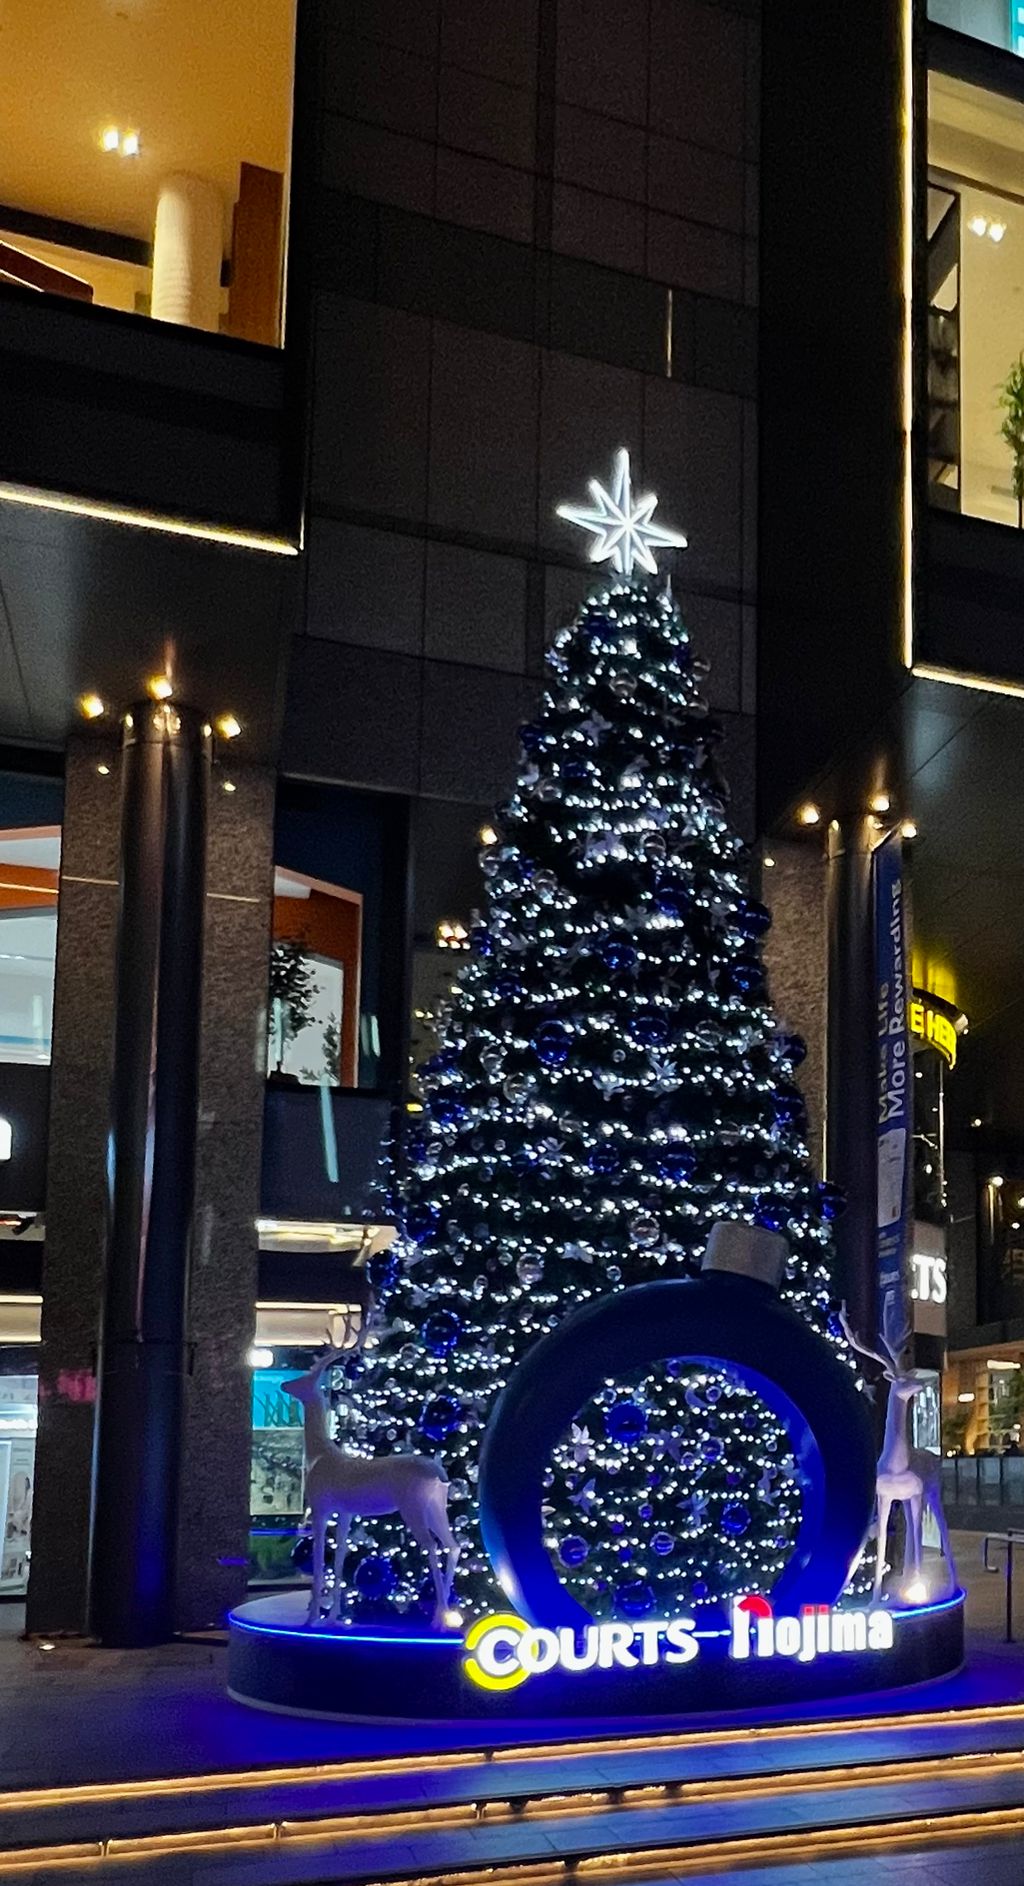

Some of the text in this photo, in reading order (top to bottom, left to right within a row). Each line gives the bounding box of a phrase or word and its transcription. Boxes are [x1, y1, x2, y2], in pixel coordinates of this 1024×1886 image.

[887, 1040, 906, 1118] More
[911, 1254, 947, 1304] TS
[465, 1594, 894, 1690] COURTS nojima
